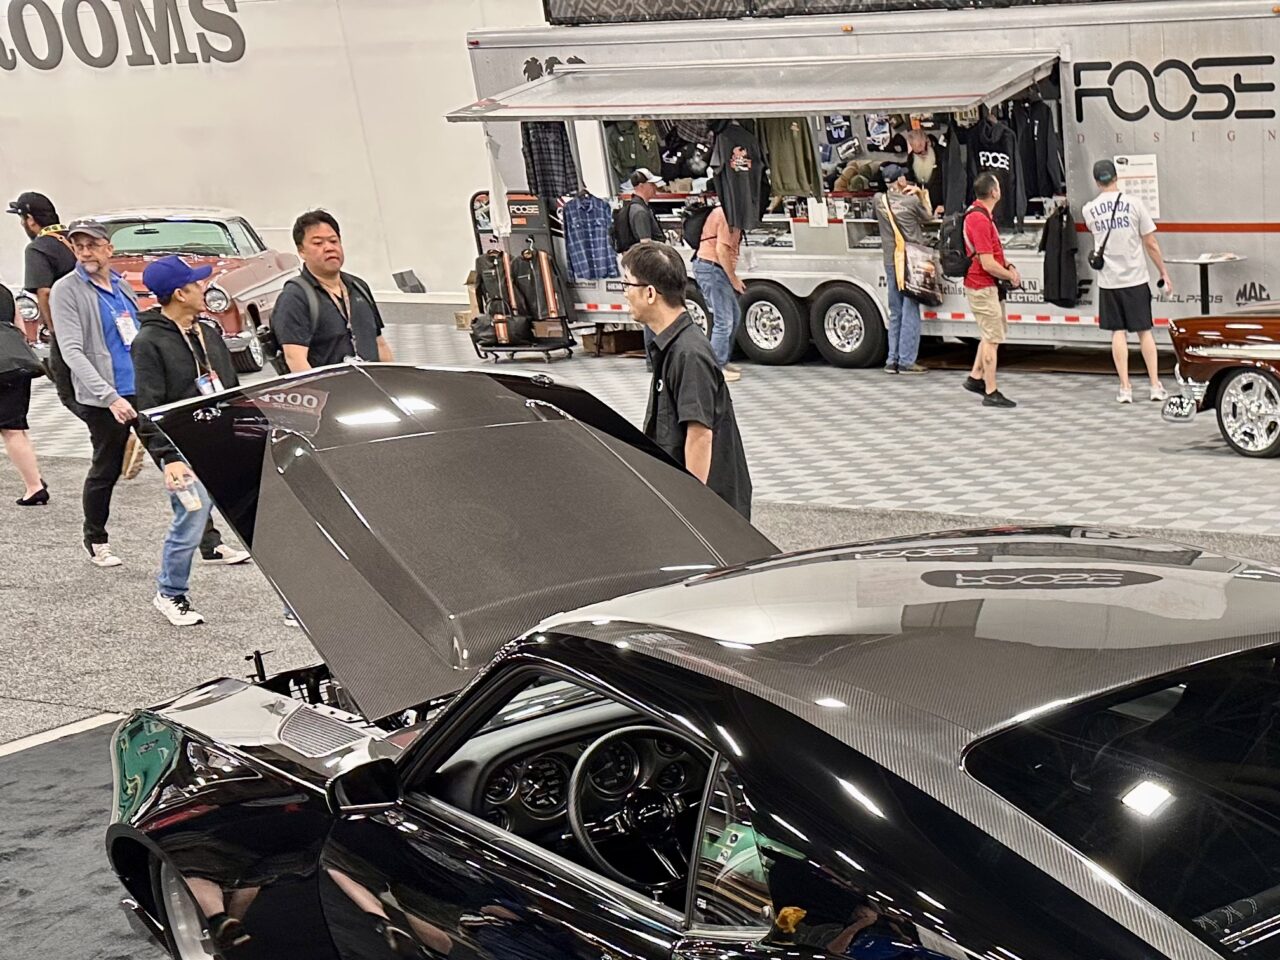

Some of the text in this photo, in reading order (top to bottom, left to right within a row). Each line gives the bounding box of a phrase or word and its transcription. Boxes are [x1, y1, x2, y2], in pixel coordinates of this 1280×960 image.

[0, 0, 246, 70] OOMS
[1074, 56, 1275, 123] FOOSE
[1077, 130, 1276, 143] DESIGN
[979, 151, 1009, 170] FOOSE
[509, 205, 539, 214] FOOSE
[1090, 200, 1129, 219] FLORDA
[1095, 216, 1129, 231] GATORS
[1006, 293, 1044, 302] LECTRIC
[1236, 282, 1270, 301] MAC
